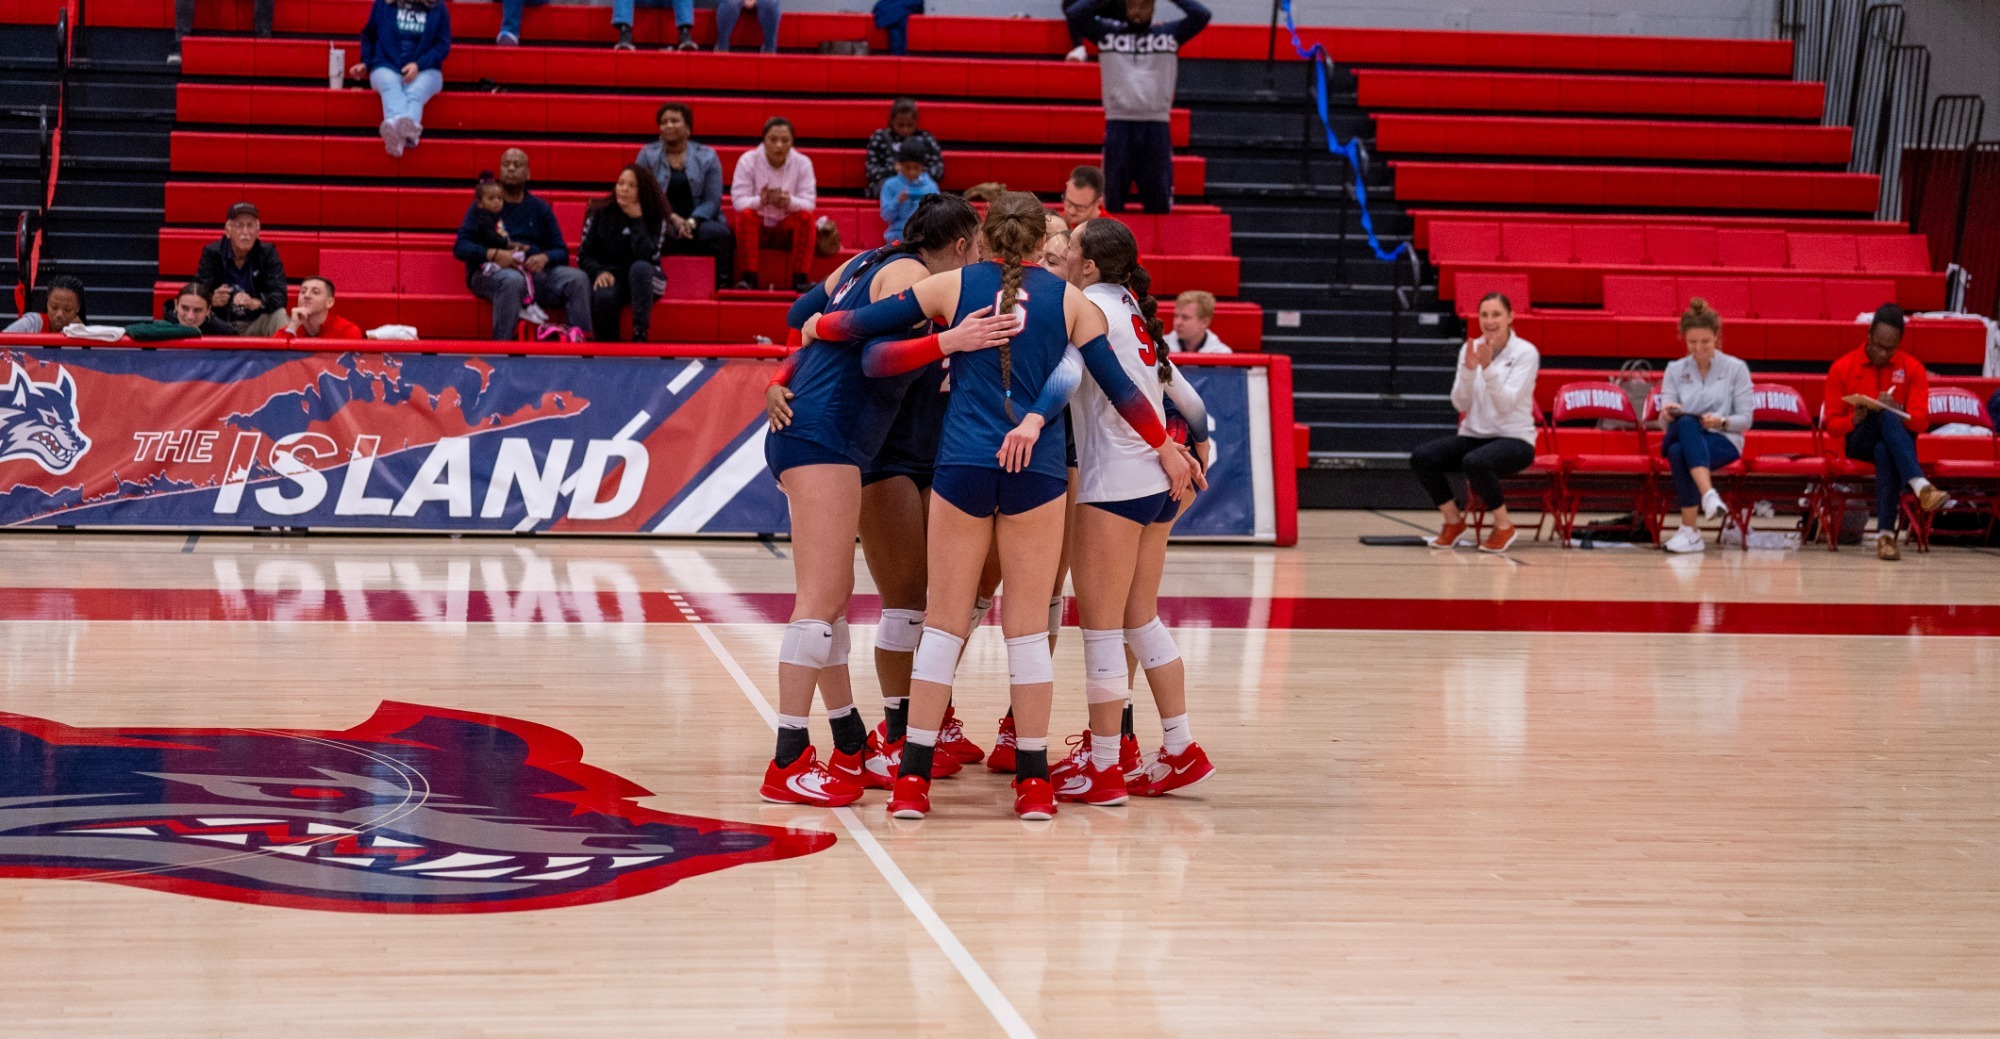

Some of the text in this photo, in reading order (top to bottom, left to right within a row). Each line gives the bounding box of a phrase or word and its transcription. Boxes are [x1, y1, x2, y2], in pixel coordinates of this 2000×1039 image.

[1130, 313, 1157, 367] 9
[1563, 389, 1624, 412] STONY BROOK
[1767, 391, 1799, 414] BROOK
[1948, 395, 1980, 418] BROOK
[133, 429, 650, 520] THE ISLAND
